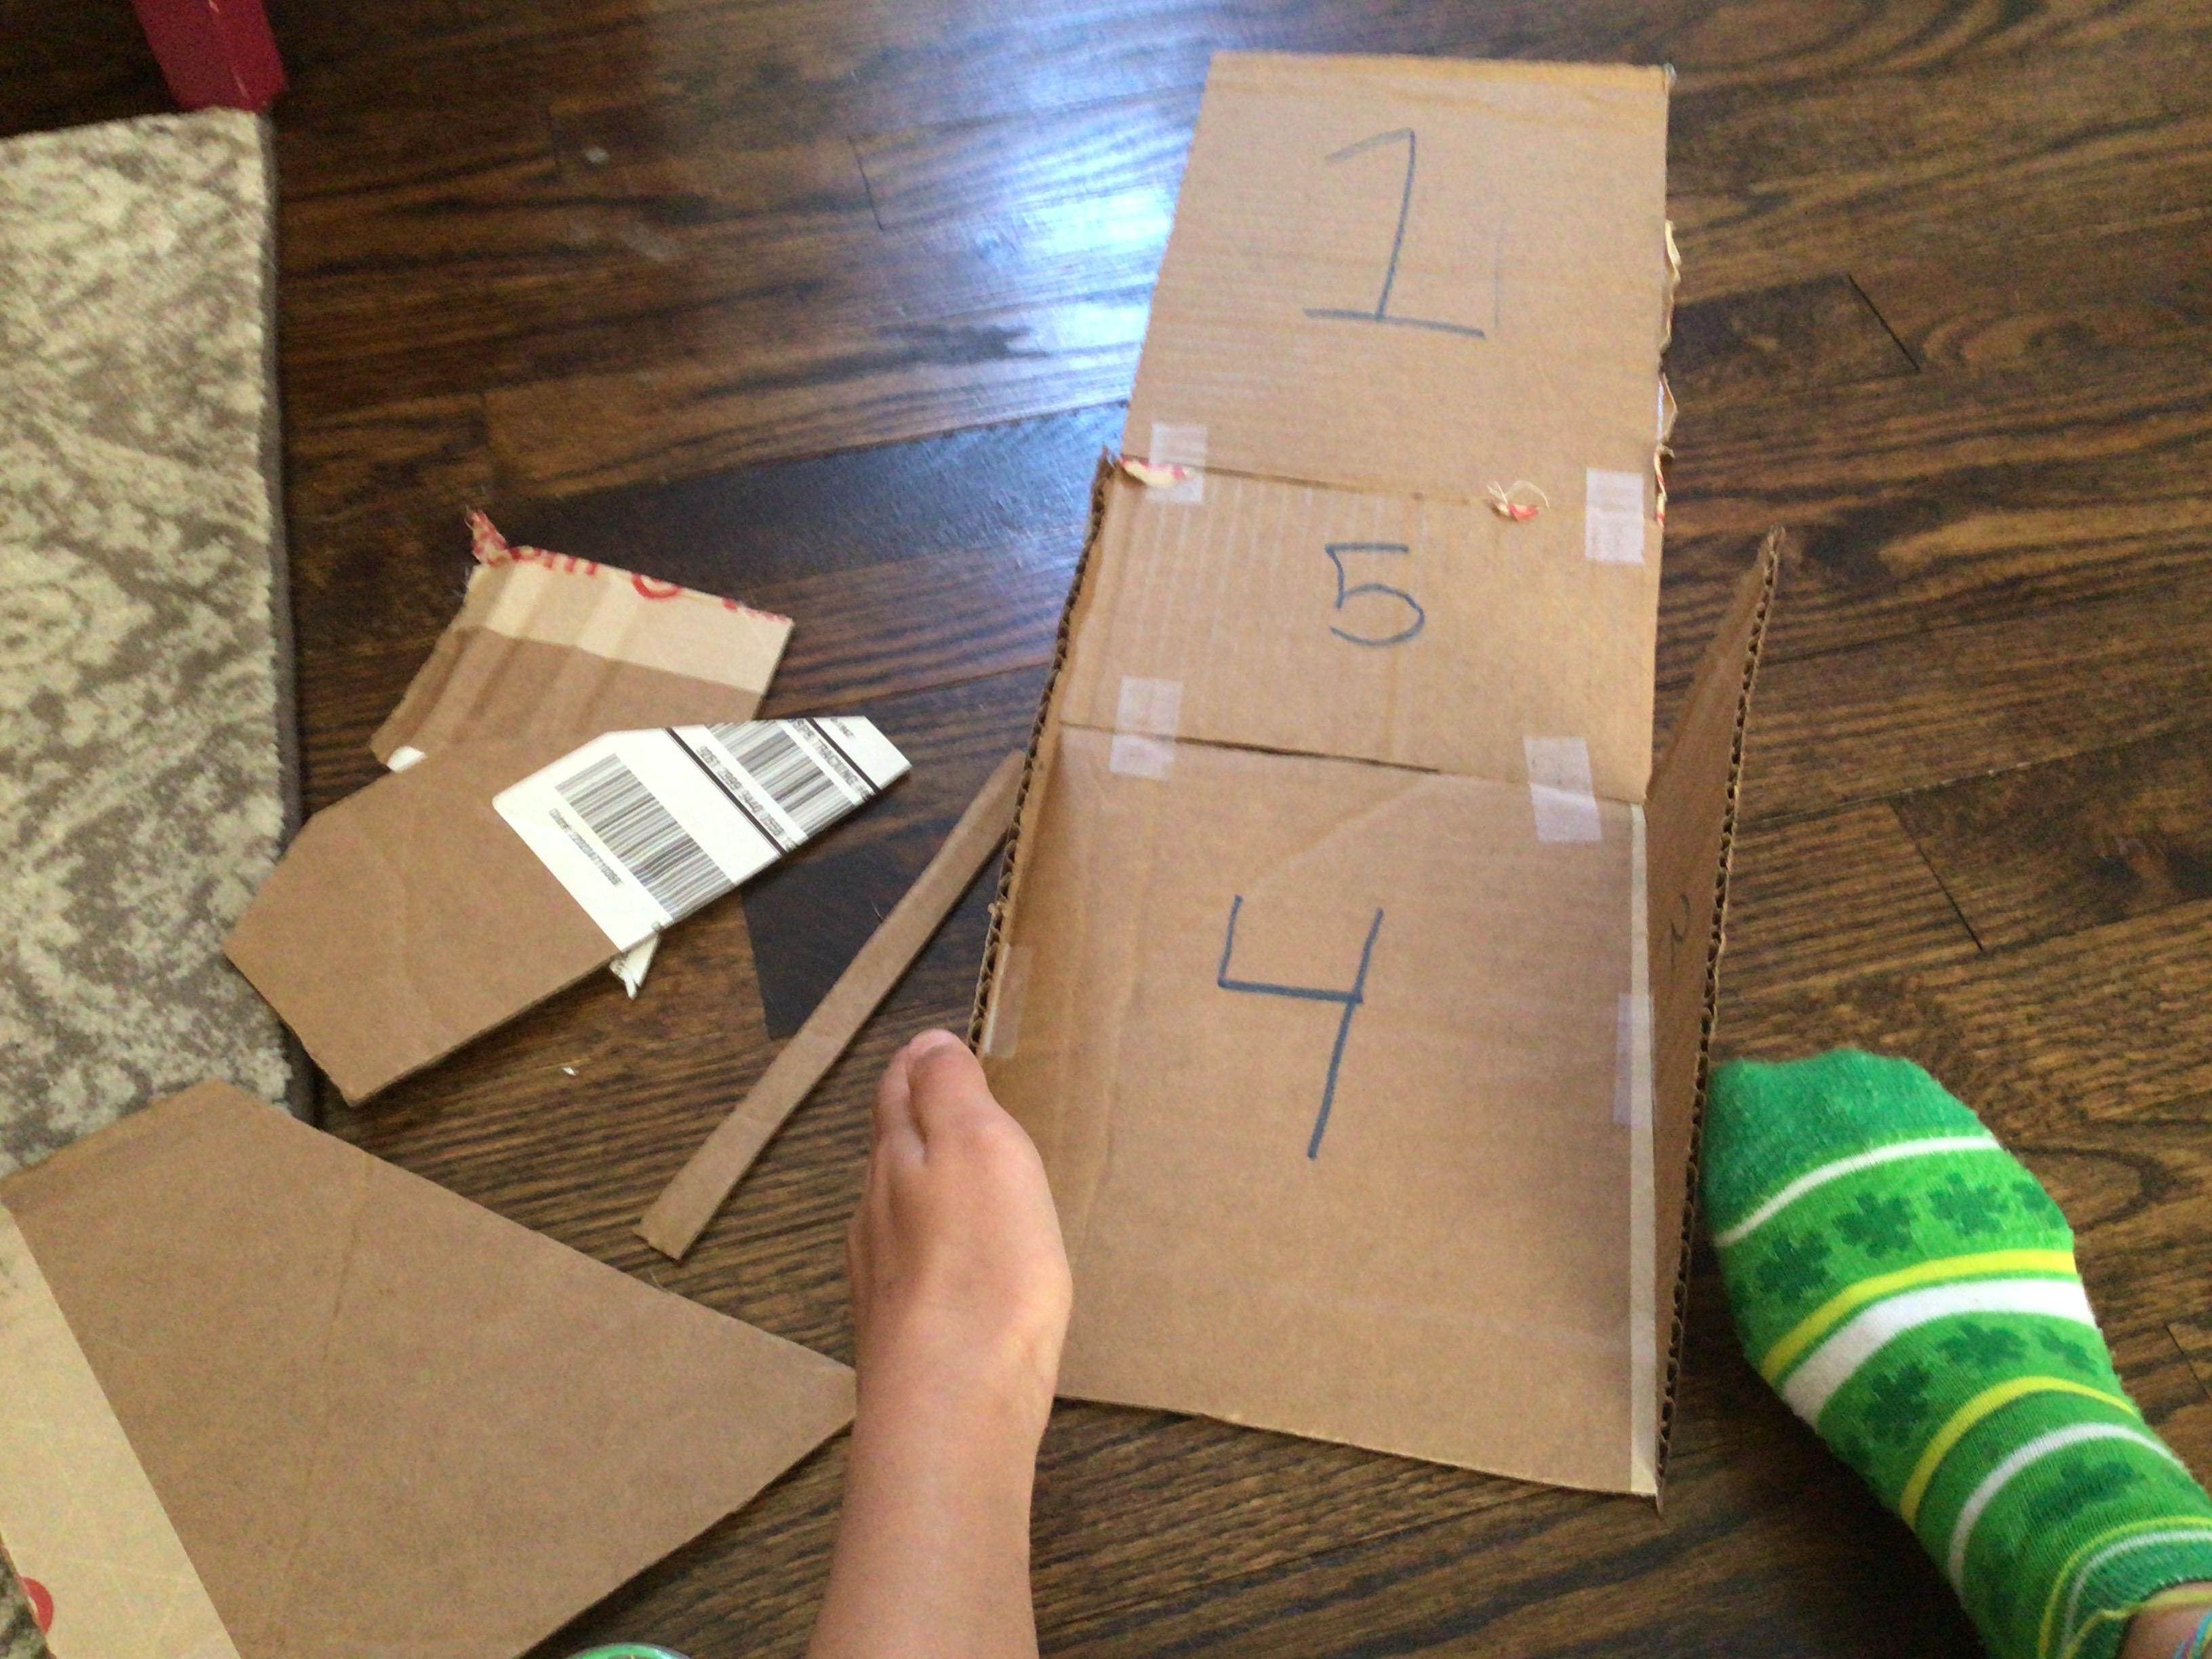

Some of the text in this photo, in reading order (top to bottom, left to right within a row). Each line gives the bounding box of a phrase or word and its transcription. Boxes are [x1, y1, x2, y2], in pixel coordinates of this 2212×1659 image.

[1303, 127, 1486, 339] 1
[1325, 543, 1425, 647] 5
[813, 739, 858, 785] TRACKING
[1218, 895, 1384, 1160] 4
